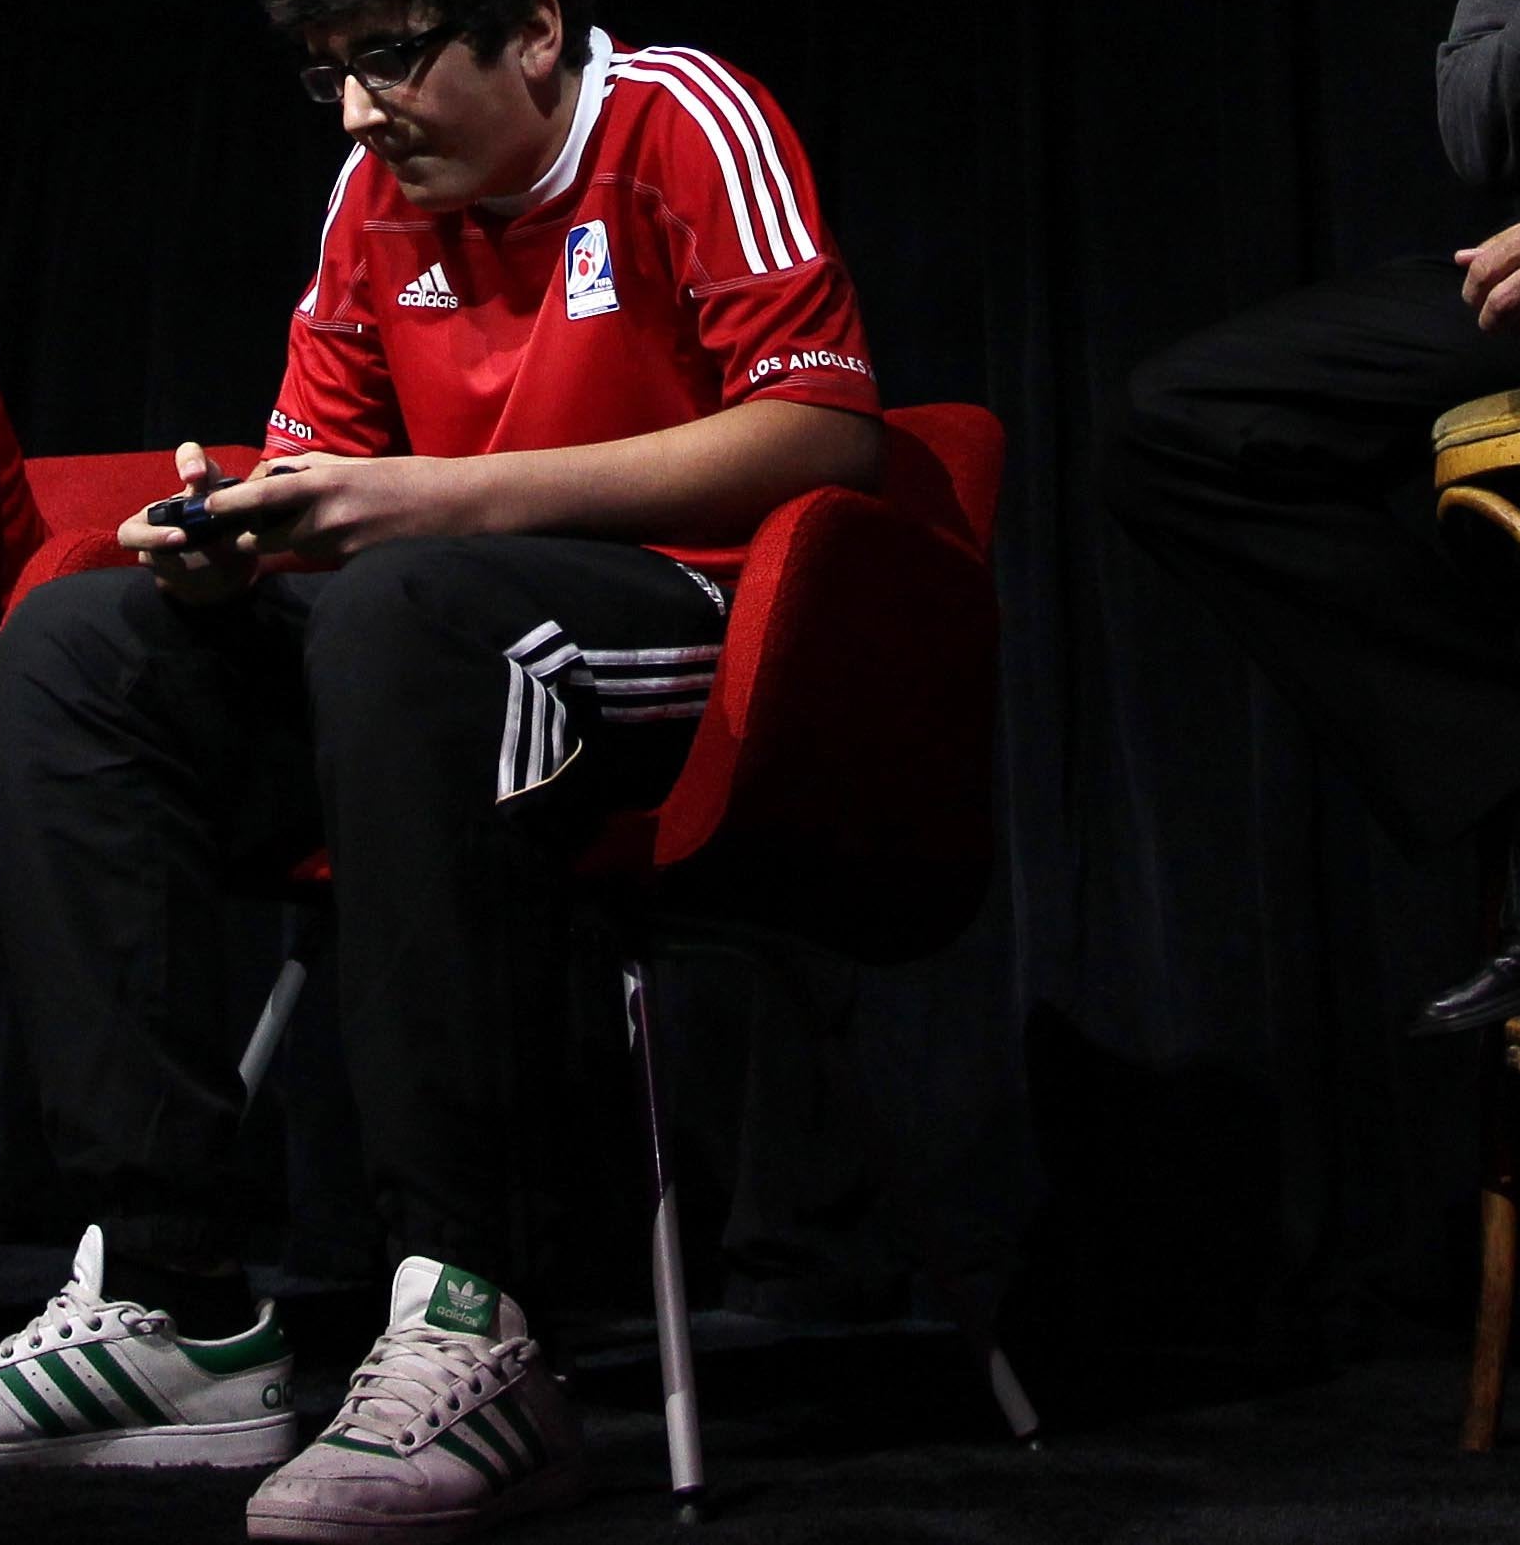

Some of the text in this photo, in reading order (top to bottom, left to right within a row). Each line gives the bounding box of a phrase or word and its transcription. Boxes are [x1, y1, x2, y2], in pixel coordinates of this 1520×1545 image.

[397, 290, 459, 309] adidas
[748, 356, 783, 384] LOS
[789, 350, 867, 375] ANGELES
